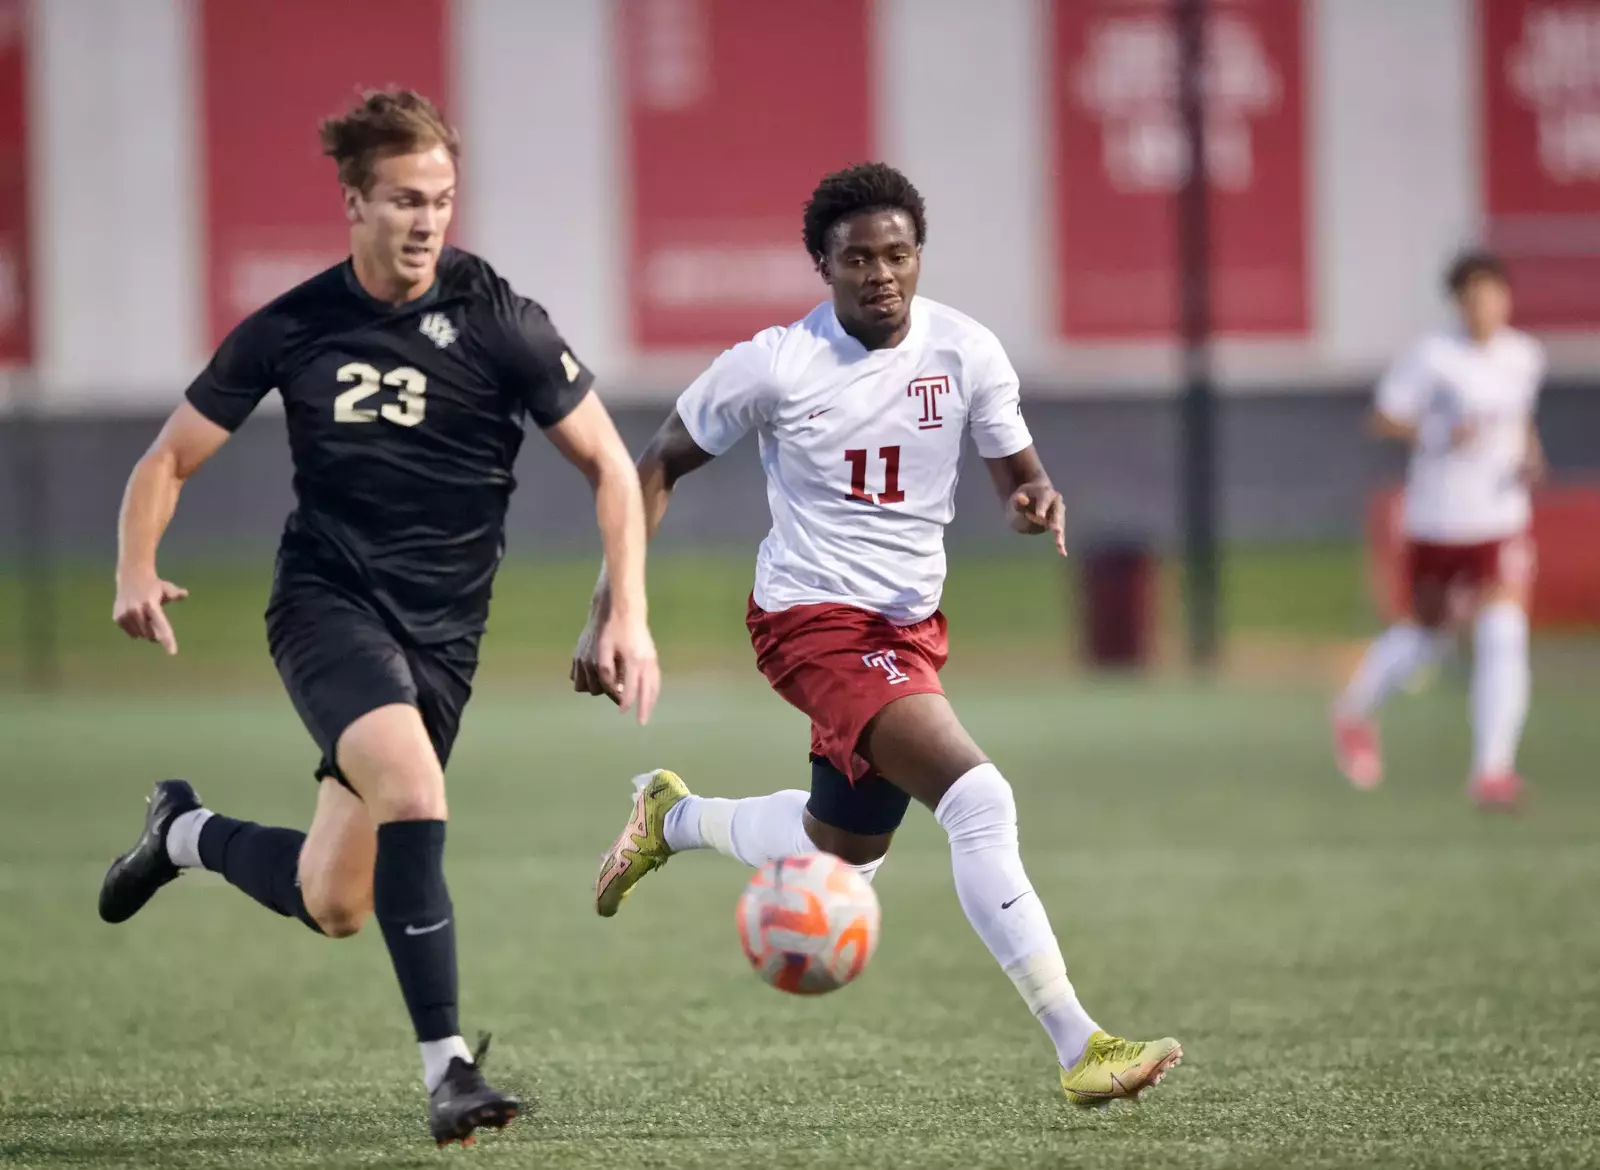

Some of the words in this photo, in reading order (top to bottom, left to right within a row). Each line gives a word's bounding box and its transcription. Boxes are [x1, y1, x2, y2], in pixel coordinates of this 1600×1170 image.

[334, 362, 427, 427] 23
[907, 375, 950, 430] T
[844, 445, 905, 504] 11
[861, 650, 910, 684] T
